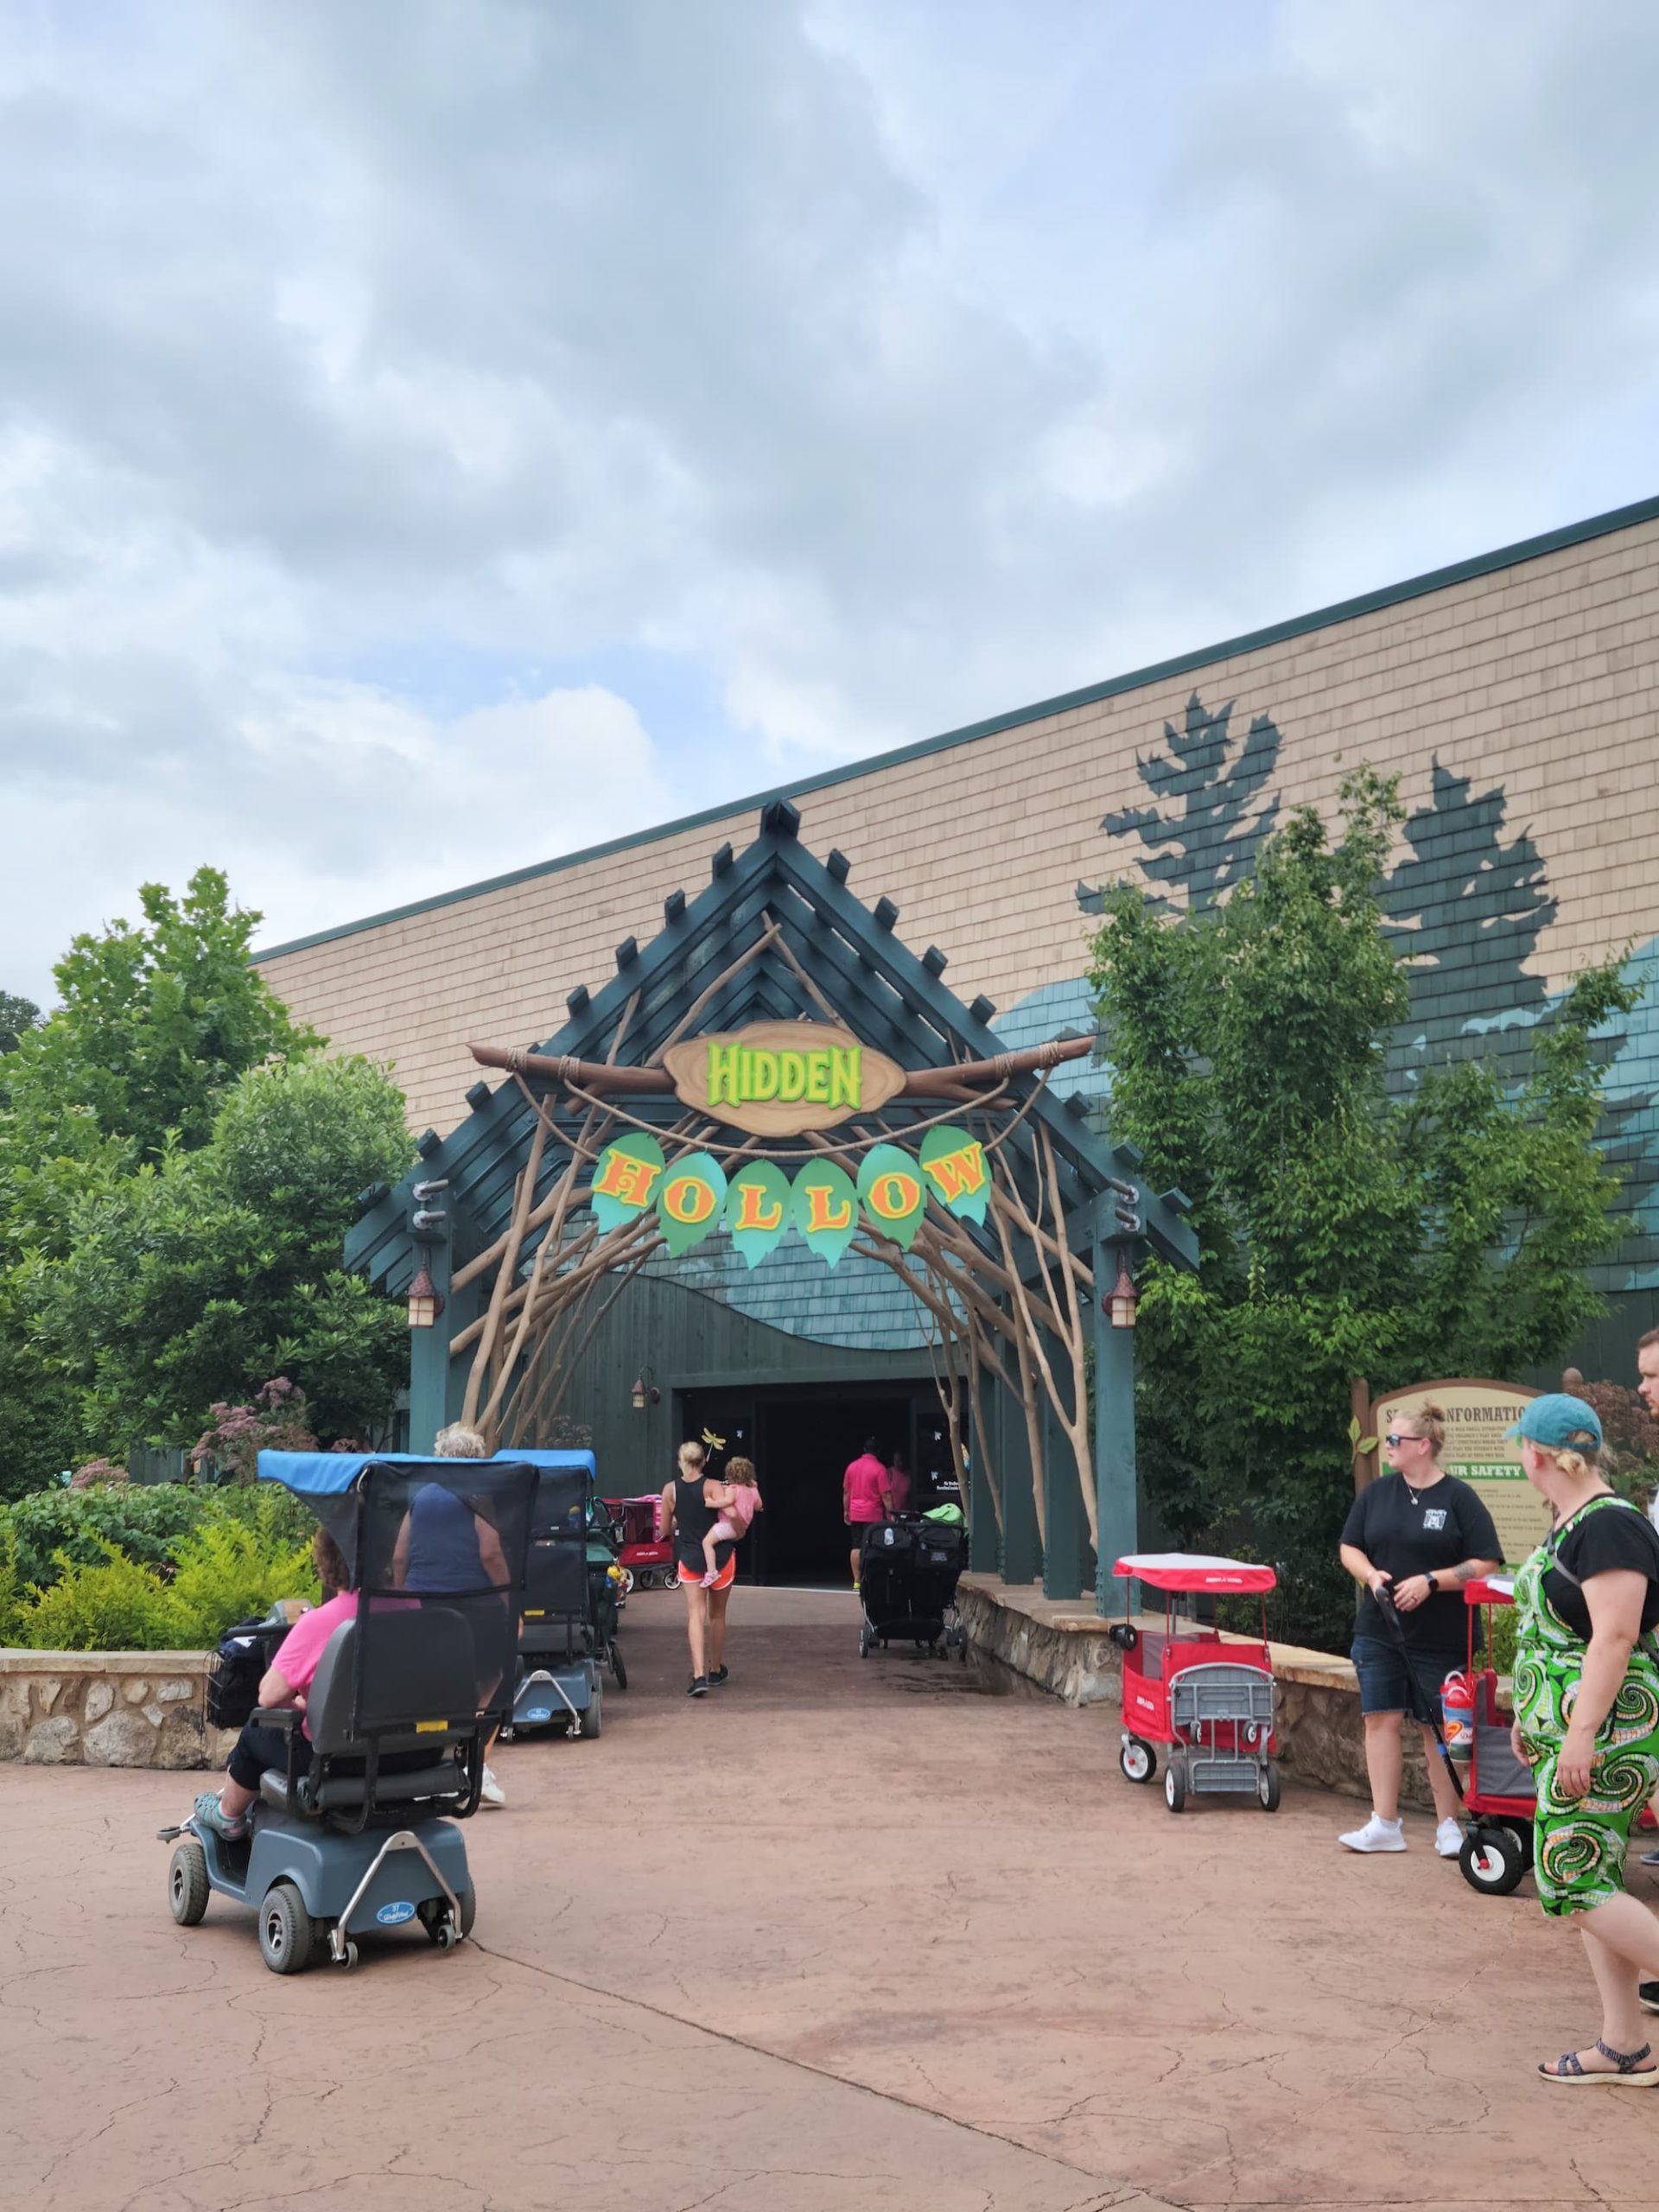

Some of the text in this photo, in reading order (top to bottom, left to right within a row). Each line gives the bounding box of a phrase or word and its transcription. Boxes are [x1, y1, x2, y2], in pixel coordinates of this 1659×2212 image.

[706, 1042, 862, 1109] HIDDEN
[592, 1141, 986, 1233] HOLLOW
[1445, 1406, 1526, 1422] NFORMATIO
[1471, 1465, 1521, 1477] SAFETY
